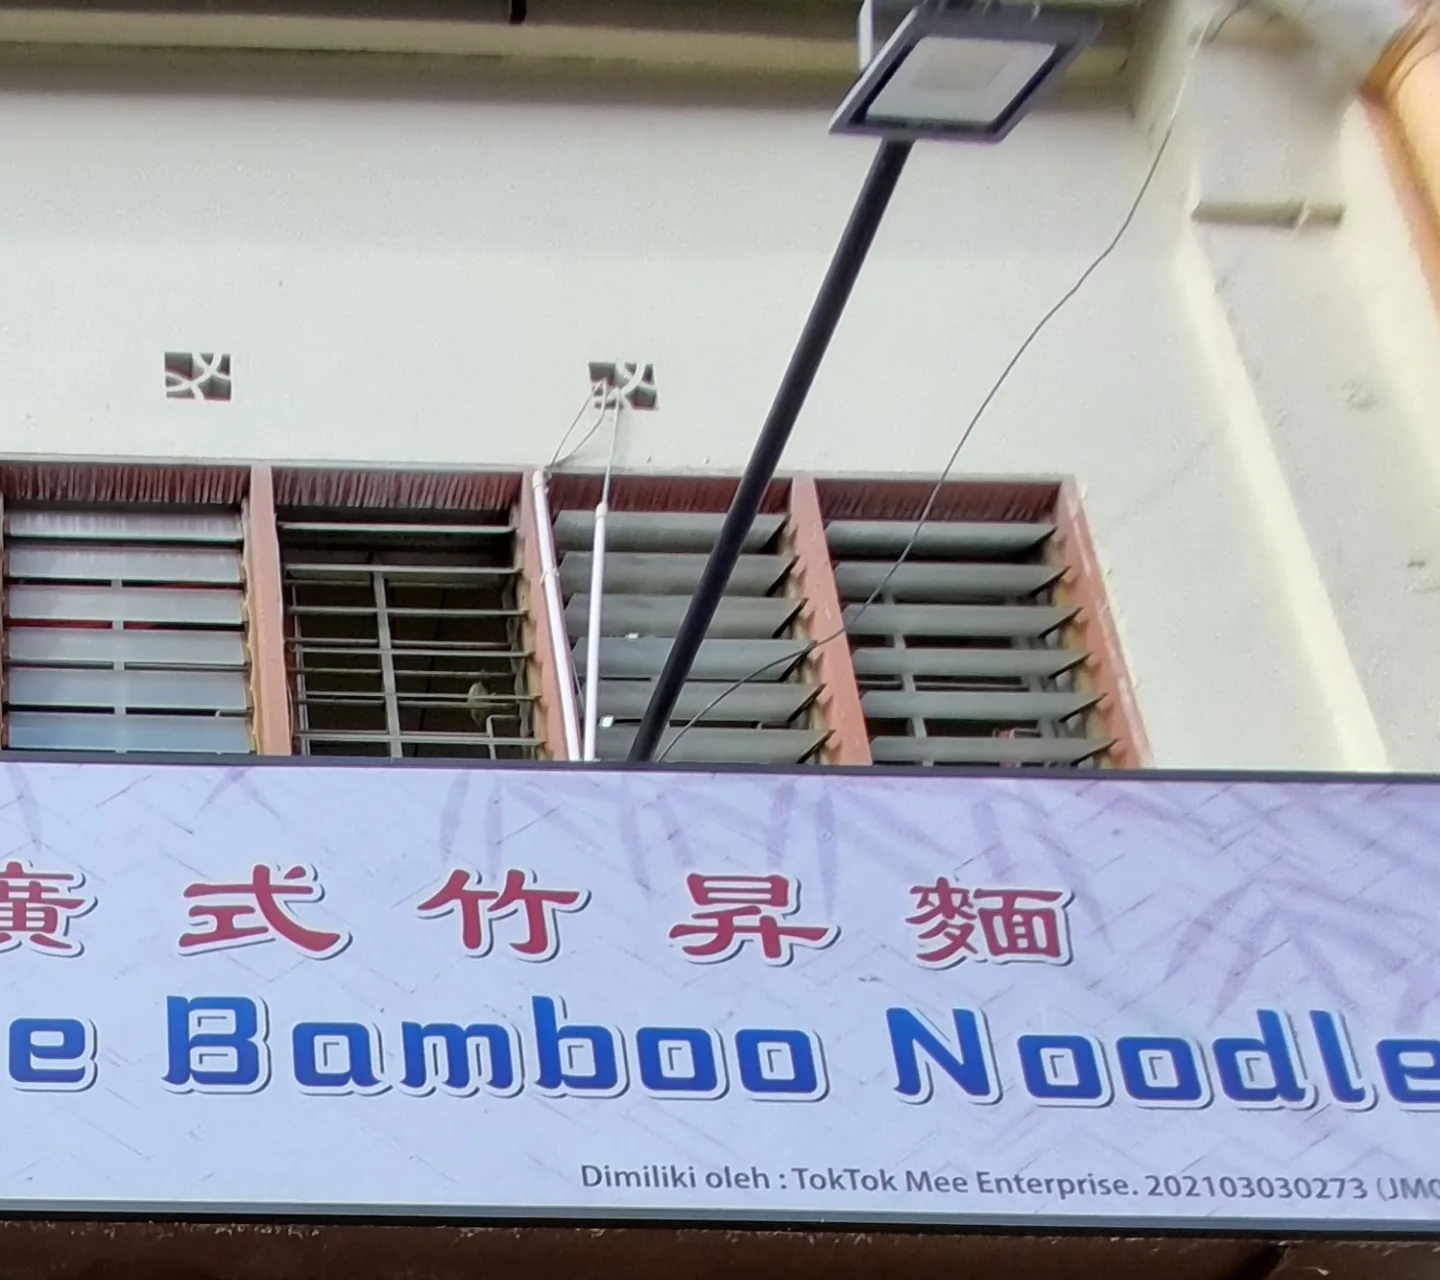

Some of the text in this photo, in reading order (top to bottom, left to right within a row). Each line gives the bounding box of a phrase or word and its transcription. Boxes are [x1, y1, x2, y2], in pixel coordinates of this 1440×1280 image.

[161, 995, 825, 1103] Bamboo
[580, 1164, 697, 1188] Dimiliki
[706, 1166, 770, 1189] oleh
[792, 1167, 898, 1192] TokTok
[905, 1170, 969, 1193] Mee
[976, 1171, 1138, 1200] Enterprise.
[1145, 1173, 1369, 1199] 202103030273
